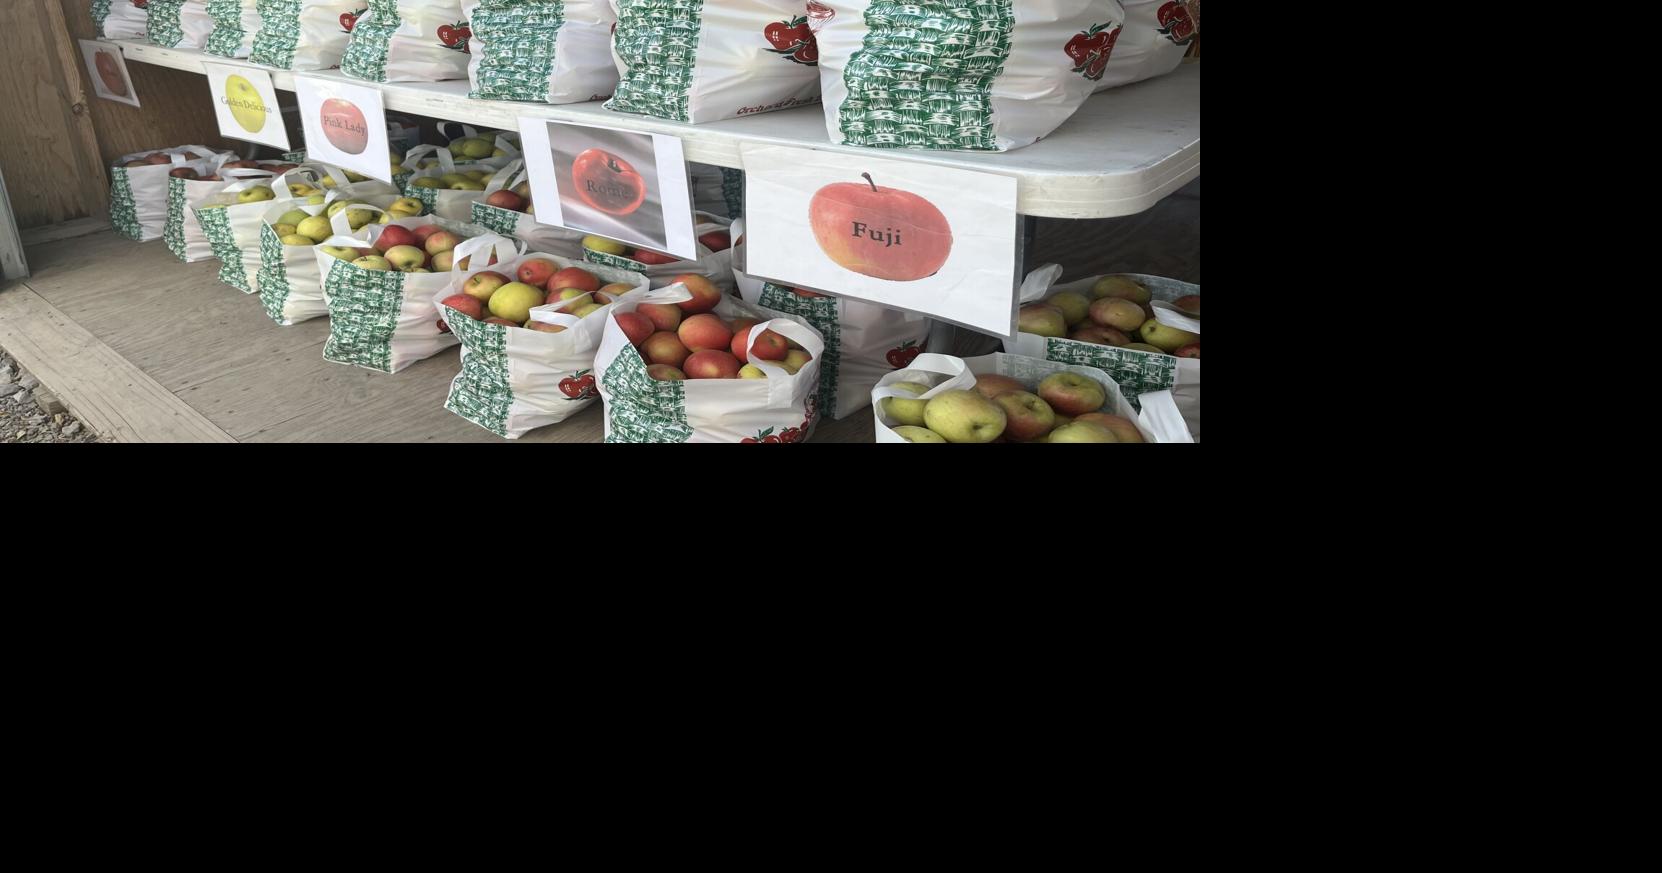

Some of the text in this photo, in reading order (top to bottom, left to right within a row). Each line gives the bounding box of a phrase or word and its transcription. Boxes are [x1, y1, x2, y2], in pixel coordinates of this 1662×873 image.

[221, 96, 272, 113] Golden Delicious
[323, 115, 366, 136] Pink Lady
[586, 180, 629, 199] Rome
[852, 221, 902, 247] Fuji
